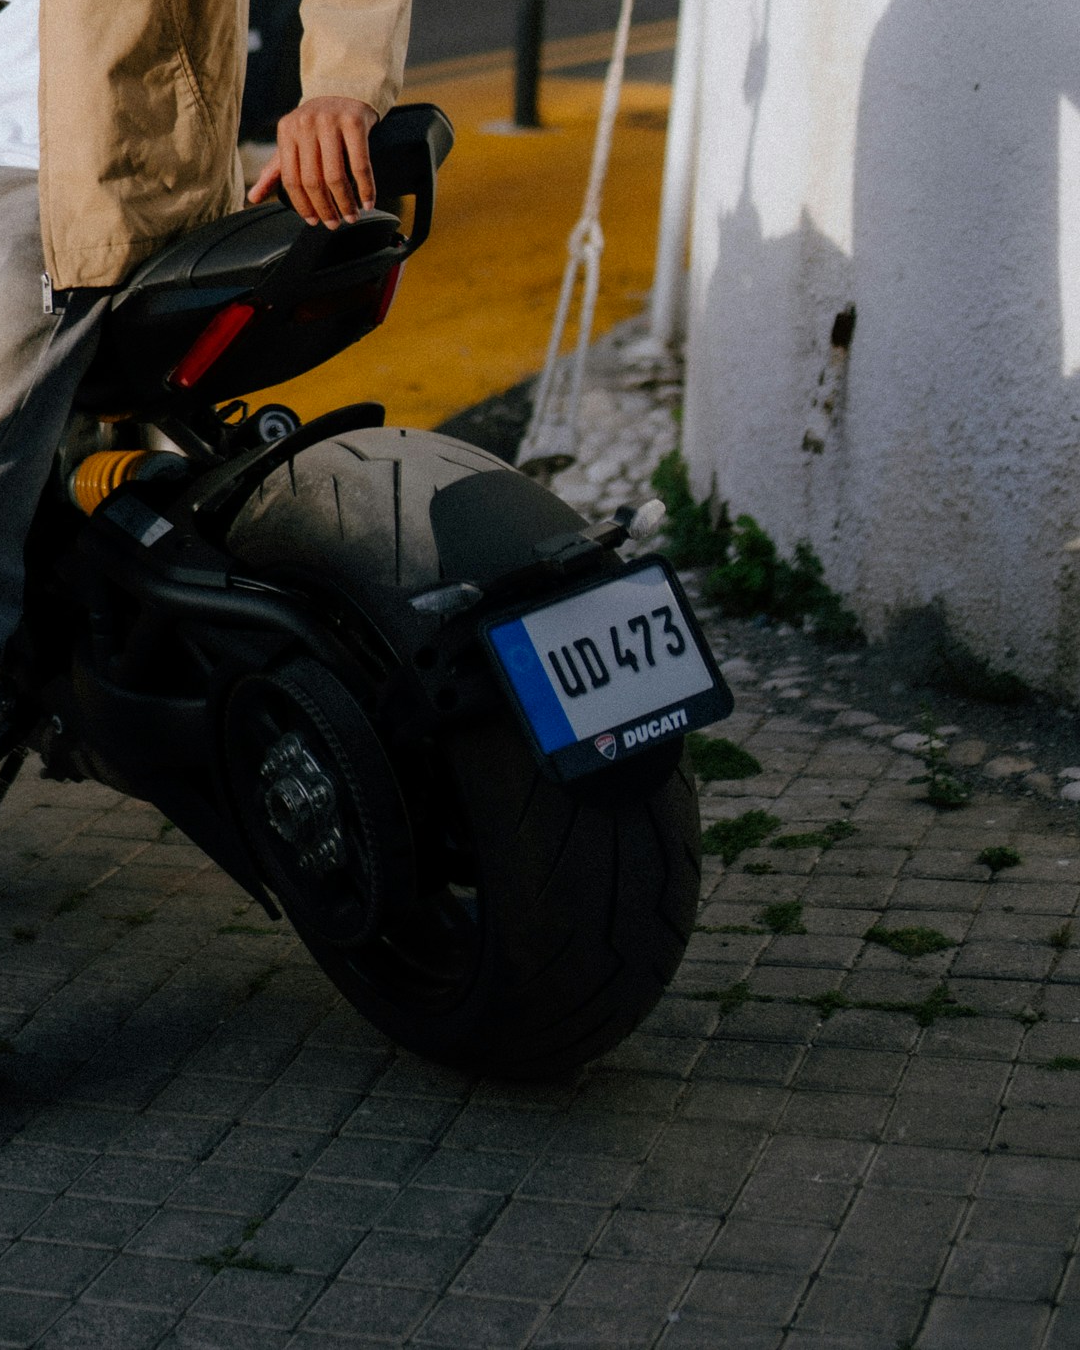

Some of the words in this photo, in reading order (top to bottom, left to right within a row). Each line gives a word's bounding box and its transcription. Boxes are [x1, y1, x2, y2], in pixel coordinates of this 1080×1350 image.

[548, 637, 610, 698] UD
[610, 605, 686, 672] 473
[622, 708, 689, 749] DUCATI
